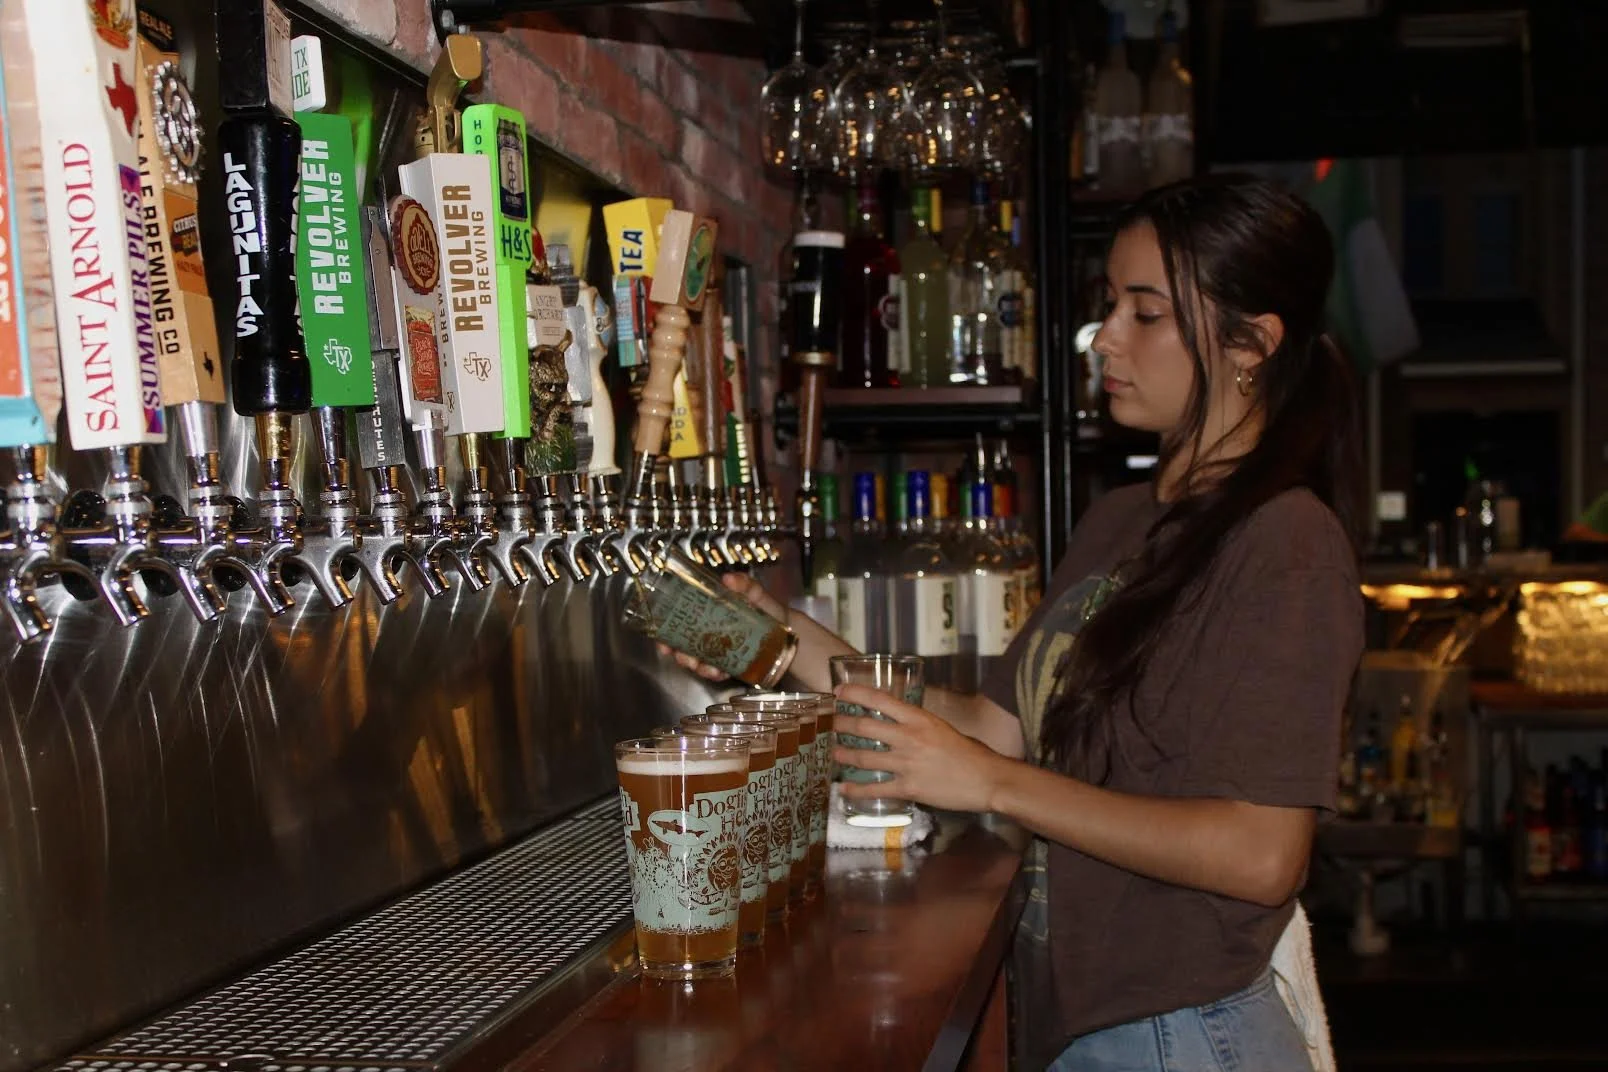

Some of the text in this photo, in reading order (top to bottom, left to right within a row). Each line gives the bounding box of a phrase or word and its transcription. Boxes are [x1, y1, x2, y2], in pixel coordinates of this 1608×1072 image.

[223, 152, 264, 337] LAGUNITAS
[302, 139, 345, 314] REVOLVER
[329, 171, 352, 284] BREWING
[442, 185, 484, 332] REVOLVER
[471, 210, 492, 304] BREWING
[501, 224, 532, 262] H&S
[620, 229, 644, 272] TEA
[63, 143, 120, 432] SAINT ARNOLD
[123, 191, 162, 410] SUMMER PILS
[437, 284, 449, 343] BREW
[163, 329, 180, 354] CO
[696, 789, 746, 818] Dogfi
[721, 809, 746, 833] He
[747, 771, 774, 795] ogfi
